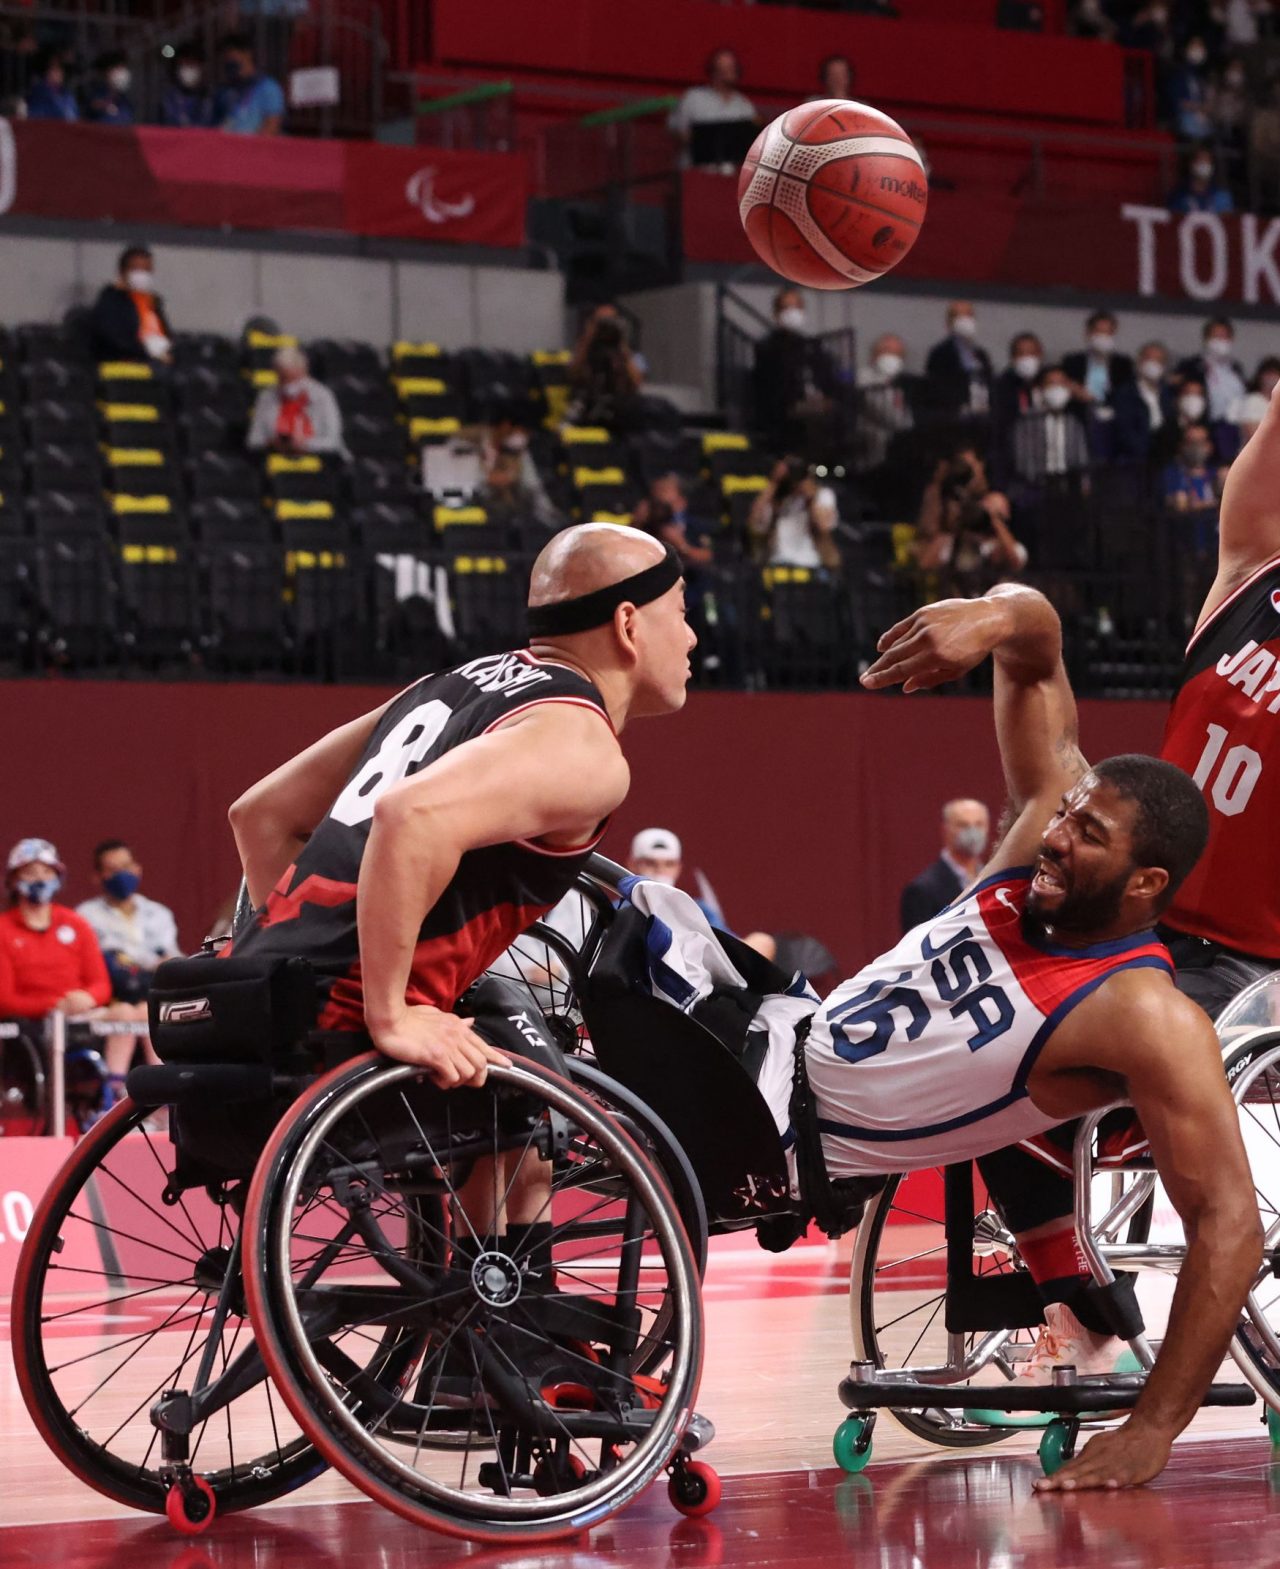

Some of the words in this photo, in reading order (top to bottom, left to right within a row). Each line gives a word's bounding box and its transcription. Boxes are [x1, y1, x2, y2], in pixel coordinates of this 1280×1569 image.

[329, 698, 453, 827] 8
[1191, 722, 1263, 817] 10
[826, 970, 932, 1064] 16
[920, 908, 1016, 1054] USA
[1225, 1052, 1254, 1082] RGY
